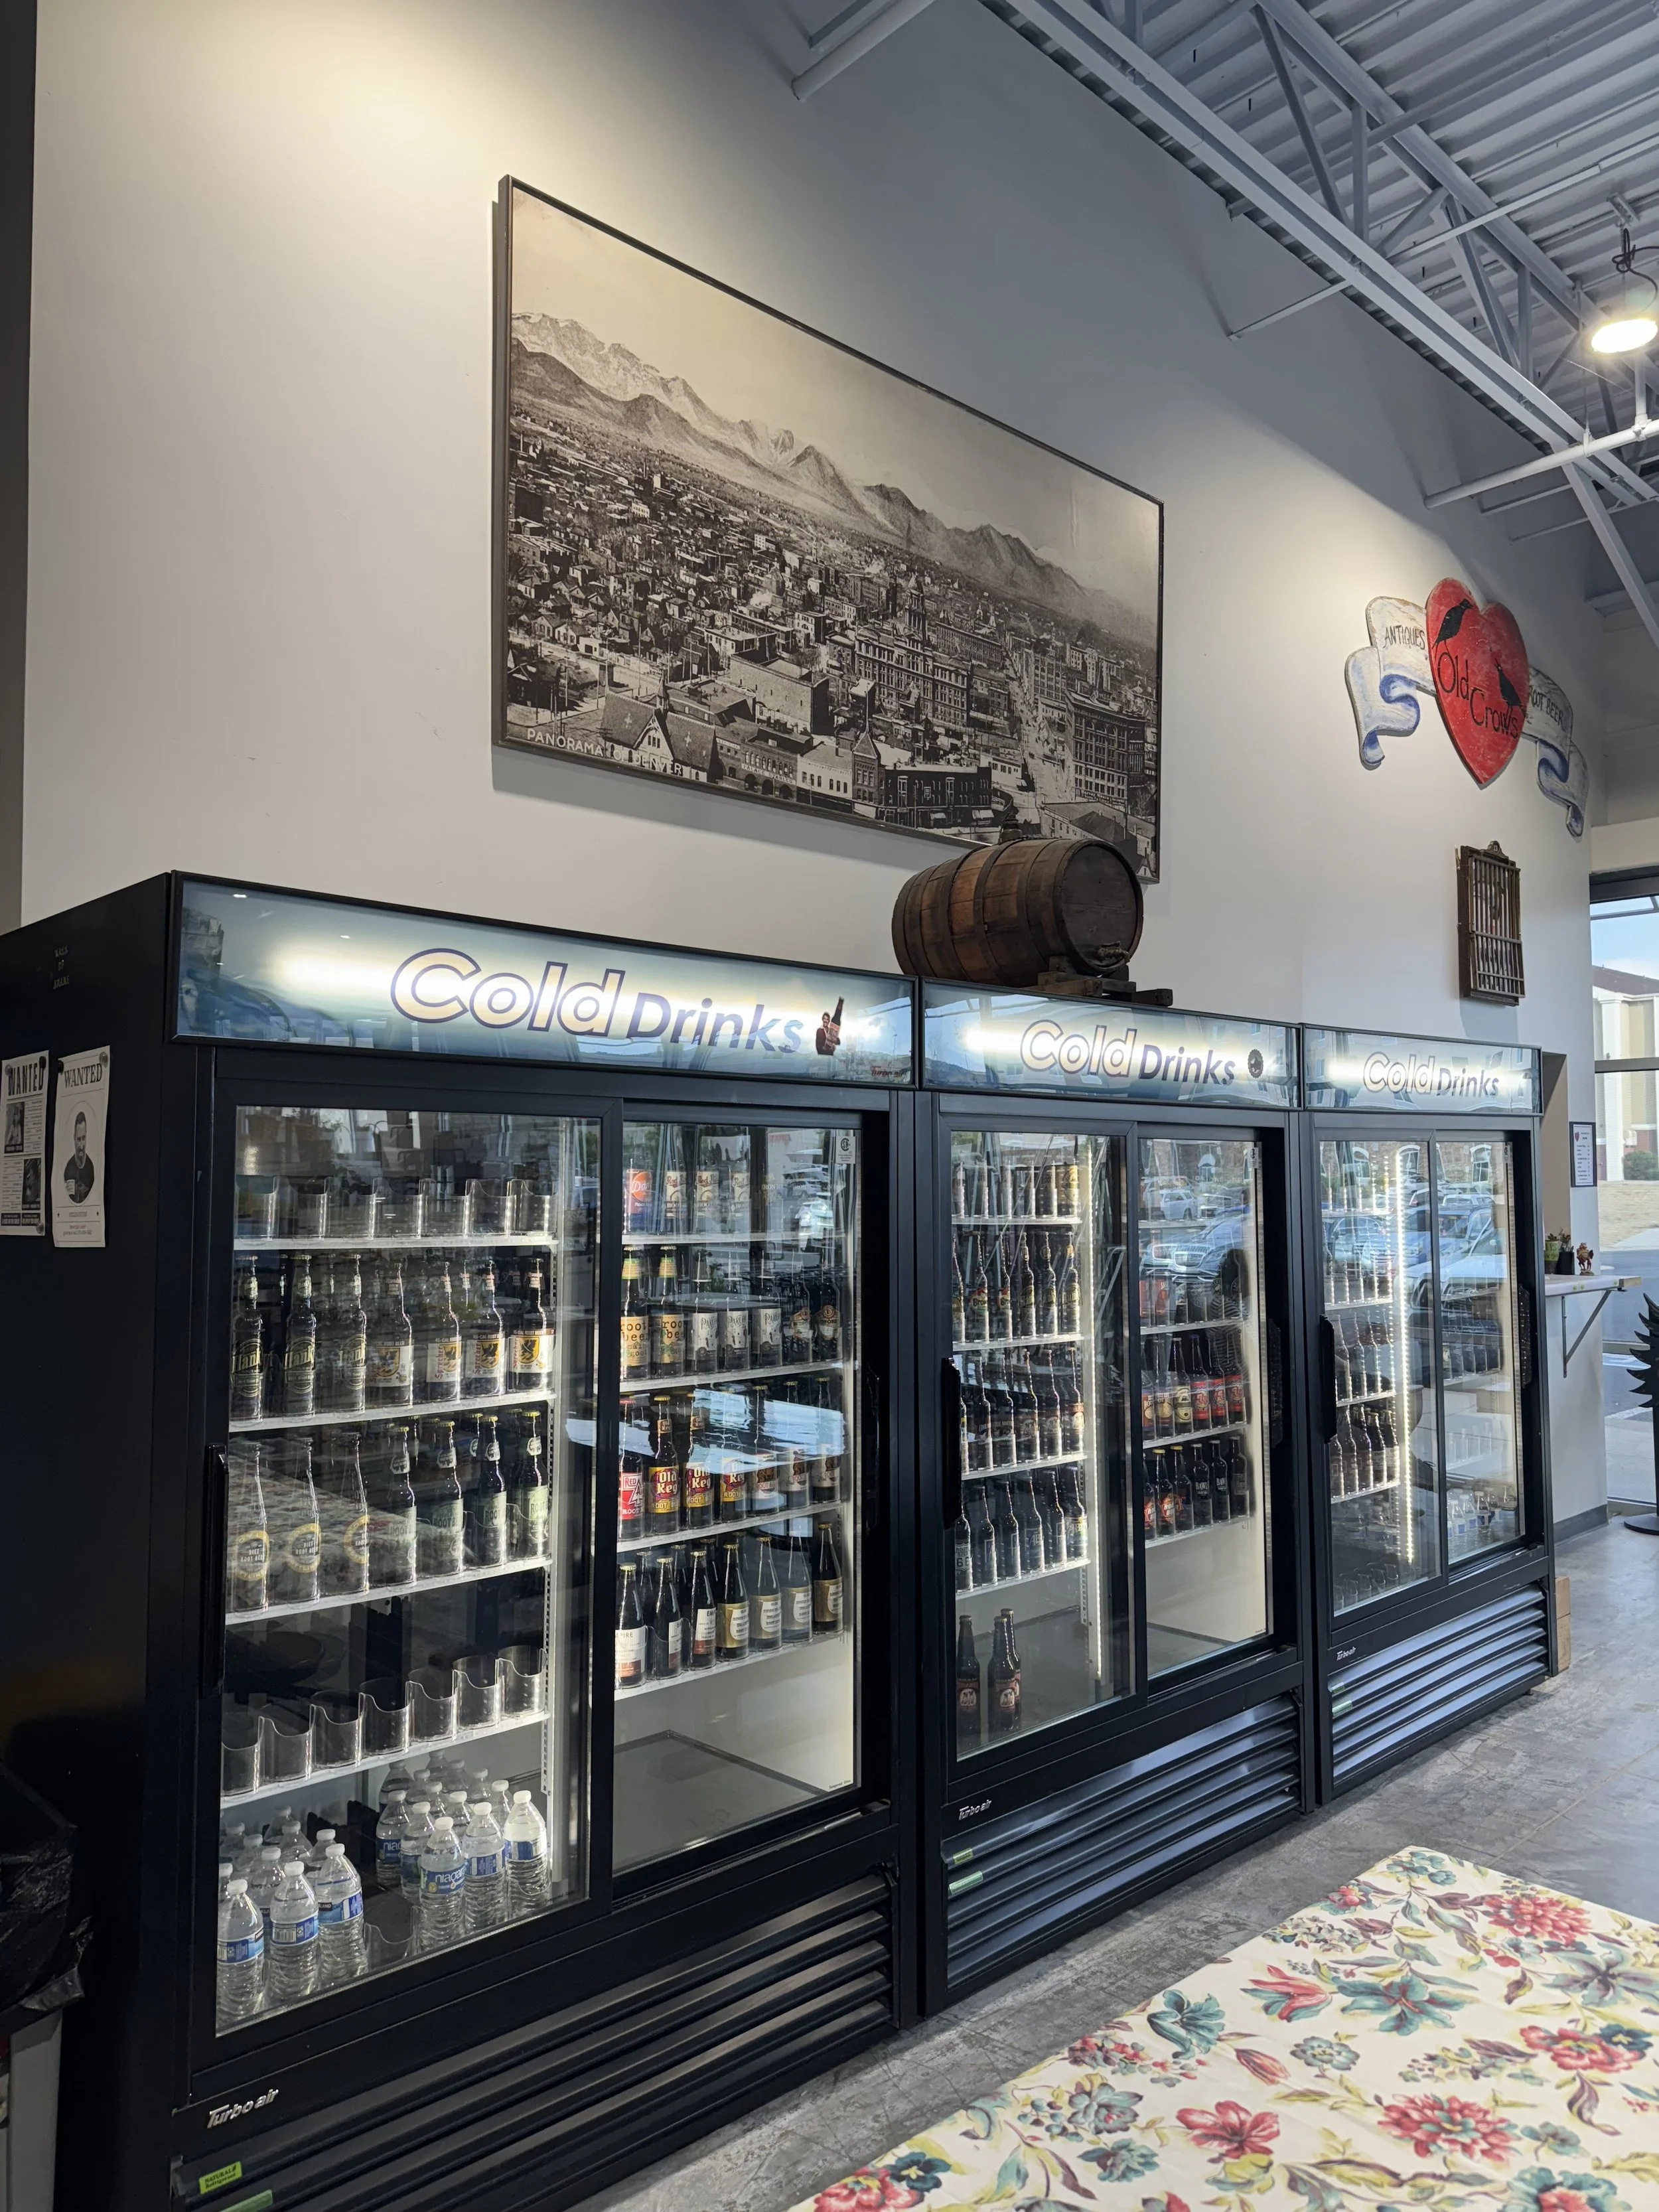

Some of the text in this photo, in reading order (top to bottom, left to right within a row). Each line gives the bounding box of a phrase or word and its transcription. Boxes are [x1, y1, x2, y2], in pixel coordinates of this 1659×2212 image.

[1383, 625, 1426, 650] ANTIQUES
[1437, 652, 1519, 739] Old Crows
[1546, 698, 1565, 732] BEER
[528, 728, 604, 757] PANORAMA
[634, 754, 684, 775] DENVER
[390, 948, 804, 1054] Cold Drinks
[1020, 1019, 1236, 1087] Cold Drinks
[8, 1062, 44, 1096] WANTED
[64, 1063, 103, 1089] WANTED
[1363, 1053, 1500, 1098] Cold Drinks
[656, 1484, 678, 1495] Keg
[659, 1471, 677, 1483] Old
[691, 1478, 711, 1489] Keg
[959, 1799, 991, 1820] Turbo air
[206, 2089, 279, 2129] Turbo air
[204, 2168, 232, 2183] NATURAL
